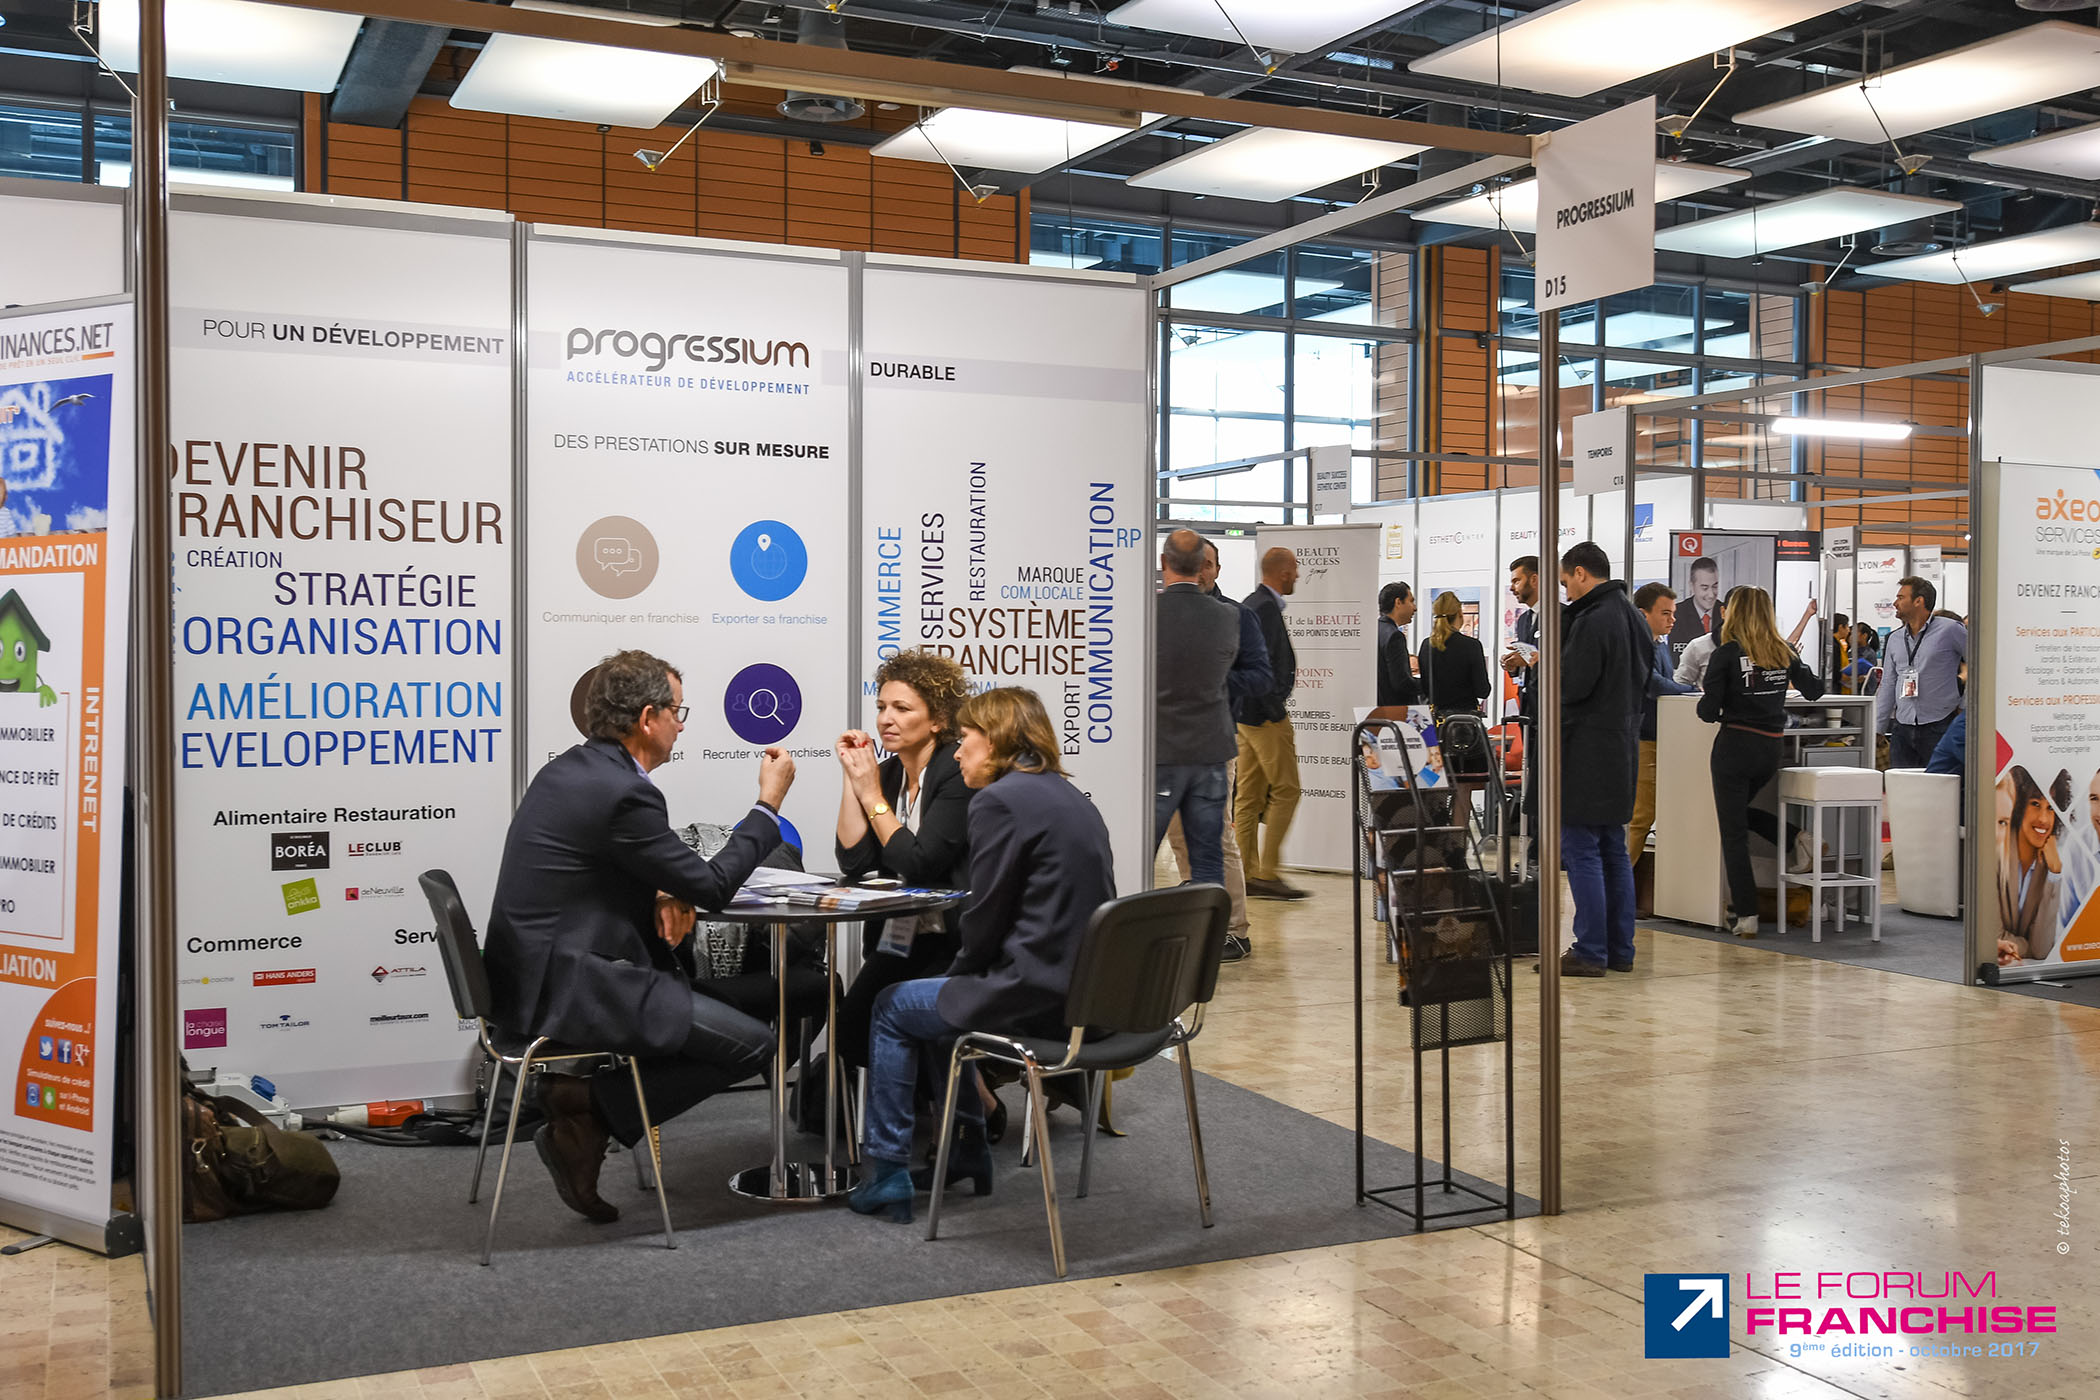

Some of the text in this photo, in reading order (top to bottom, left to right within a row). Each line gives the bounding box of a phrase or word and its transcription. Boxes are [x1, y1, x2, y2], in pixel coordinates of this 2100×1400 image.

[1556, 188, 1635, 230] PROGRESSIUM
[1545, 275, 1567, 298] D15
[0, 322, 113, 360] INANCES.NET
[203, 319, 504, 354] POUR UN DÉVELOPPEMENT
[870, 362, 955, 381] DURABLE
[567, 370, 809, 395] ACCÉLÉRATEUR DE DÉVELOPPEMENT
[554, 434, 829, 459] DES PRESTATIONS SUR MESURE
[170, 491, 504, 545] RANCHISEUR
[970, 461, 987, 601] RESTAURATION
[1117, 528, 1142, 549] RP
[187, 546, 282, 568] CRÉATION
[1296, 547, 1340, 557] BEAUTY
[1296, 557, 1340, 566] SUCCESS
[1858, 560, 1879, 570] LYON
[921, 512, 944, 640] SERVICES
[1018, 566, 1084, 584] MARQUE
[274, 565, 476, 607] STRATÉGIE
[878, 526, 901, 661] OMMERCE
[1000, 585, 1084, 600] COM LOCALE
[2017, 583, 2100, 598] DEVENEZ FRANC
[543, 611, 700, 625] Communiquer en franchise
[712, 613, 828, 626] Exporter sa franchise
[948, 600, 1086, 640] SYSTÈME
[1088, 482, 1114, 744] COMMUNICATION
[1315, 612, 1361, 625] BEAUTÉ
[183, 616, 501, 655] ORGANISATION
[1306, 629, 1329, 637] POINTS
[919, 644, 1086, 675] ANCHISE
[1296, 668, 1334, 678] POINTS
[1295, 680, 1324, 689] ENTE
[186, 672, 501, 720] AMÉLIORATION
[1064, 681, 1081, 755] EXPORT
[1287, 711, 1331, 719] ARFUMERIES
[0, 728, 55, 743] MMOBILIER
[1292, 723, 1318, 731] STITUTS
[1320, 723, 1329, 731] DE
[172, 728, 502, 769] EVELOPPEMENT
[703, 749, 750, 760] Recruter
[787, 748, 832, 759] nchises
[83, 687, 100, 832] INTRENET
[1320, 757, 1330, 765] DE
[22, 772, 35, 785] DE
[37, 769, 60, 786] PRÊT
[1300, 789, 1346, 799] PHARMACIES
[3, 811, 57, 830] DE CRÉDITS
[213, 805, 456, 826] Alimentaire Restauration
[275, 841, 326, 858] BORÉA
[0, 899, 15, 913] RO
[187, 935, 302, 953] Commerce
